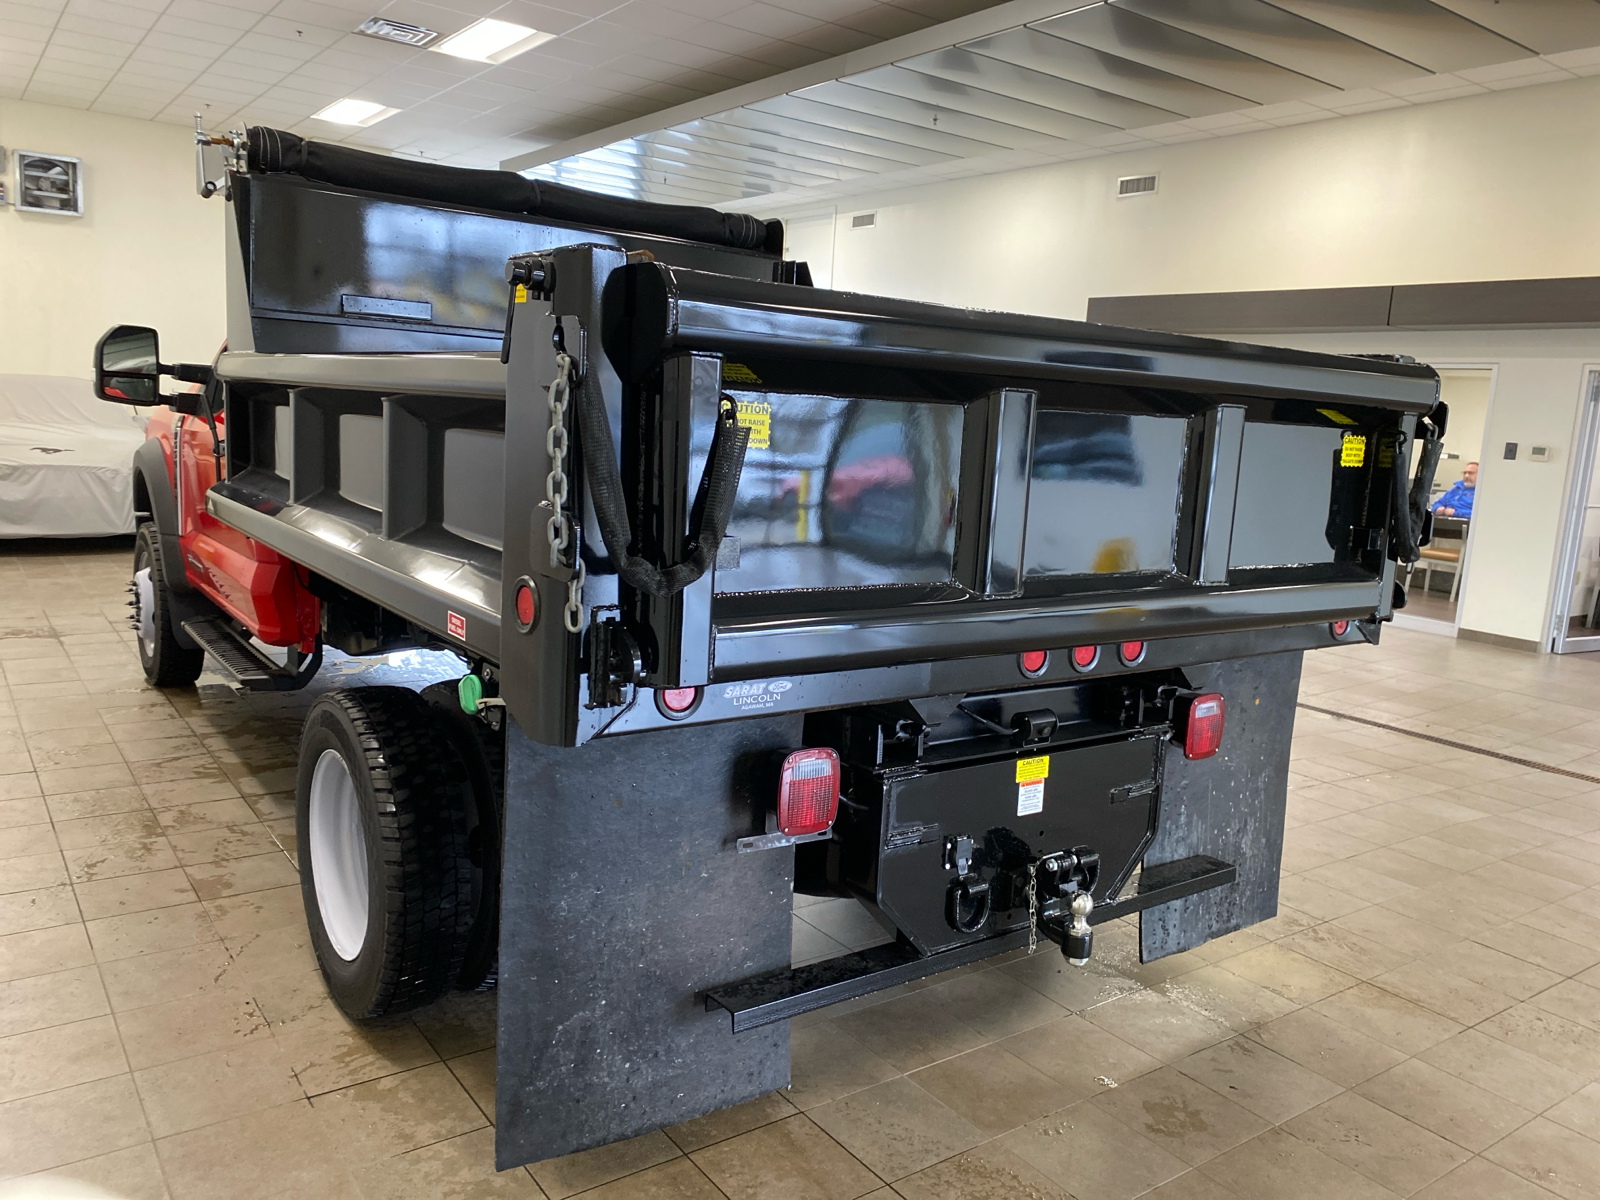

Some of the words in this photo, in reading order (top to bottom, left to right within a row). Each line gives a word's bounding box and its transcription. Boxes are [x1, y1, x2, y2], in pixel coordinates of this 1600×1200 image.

[721, 403, 769, 414] CUTION
[724, 682, 767, 698] SARAT
[769, 681, 791, 692] Ford
[733, 693, 781, 705] LINCOLN
[1022, 758, 1044, 766] CAUTION
